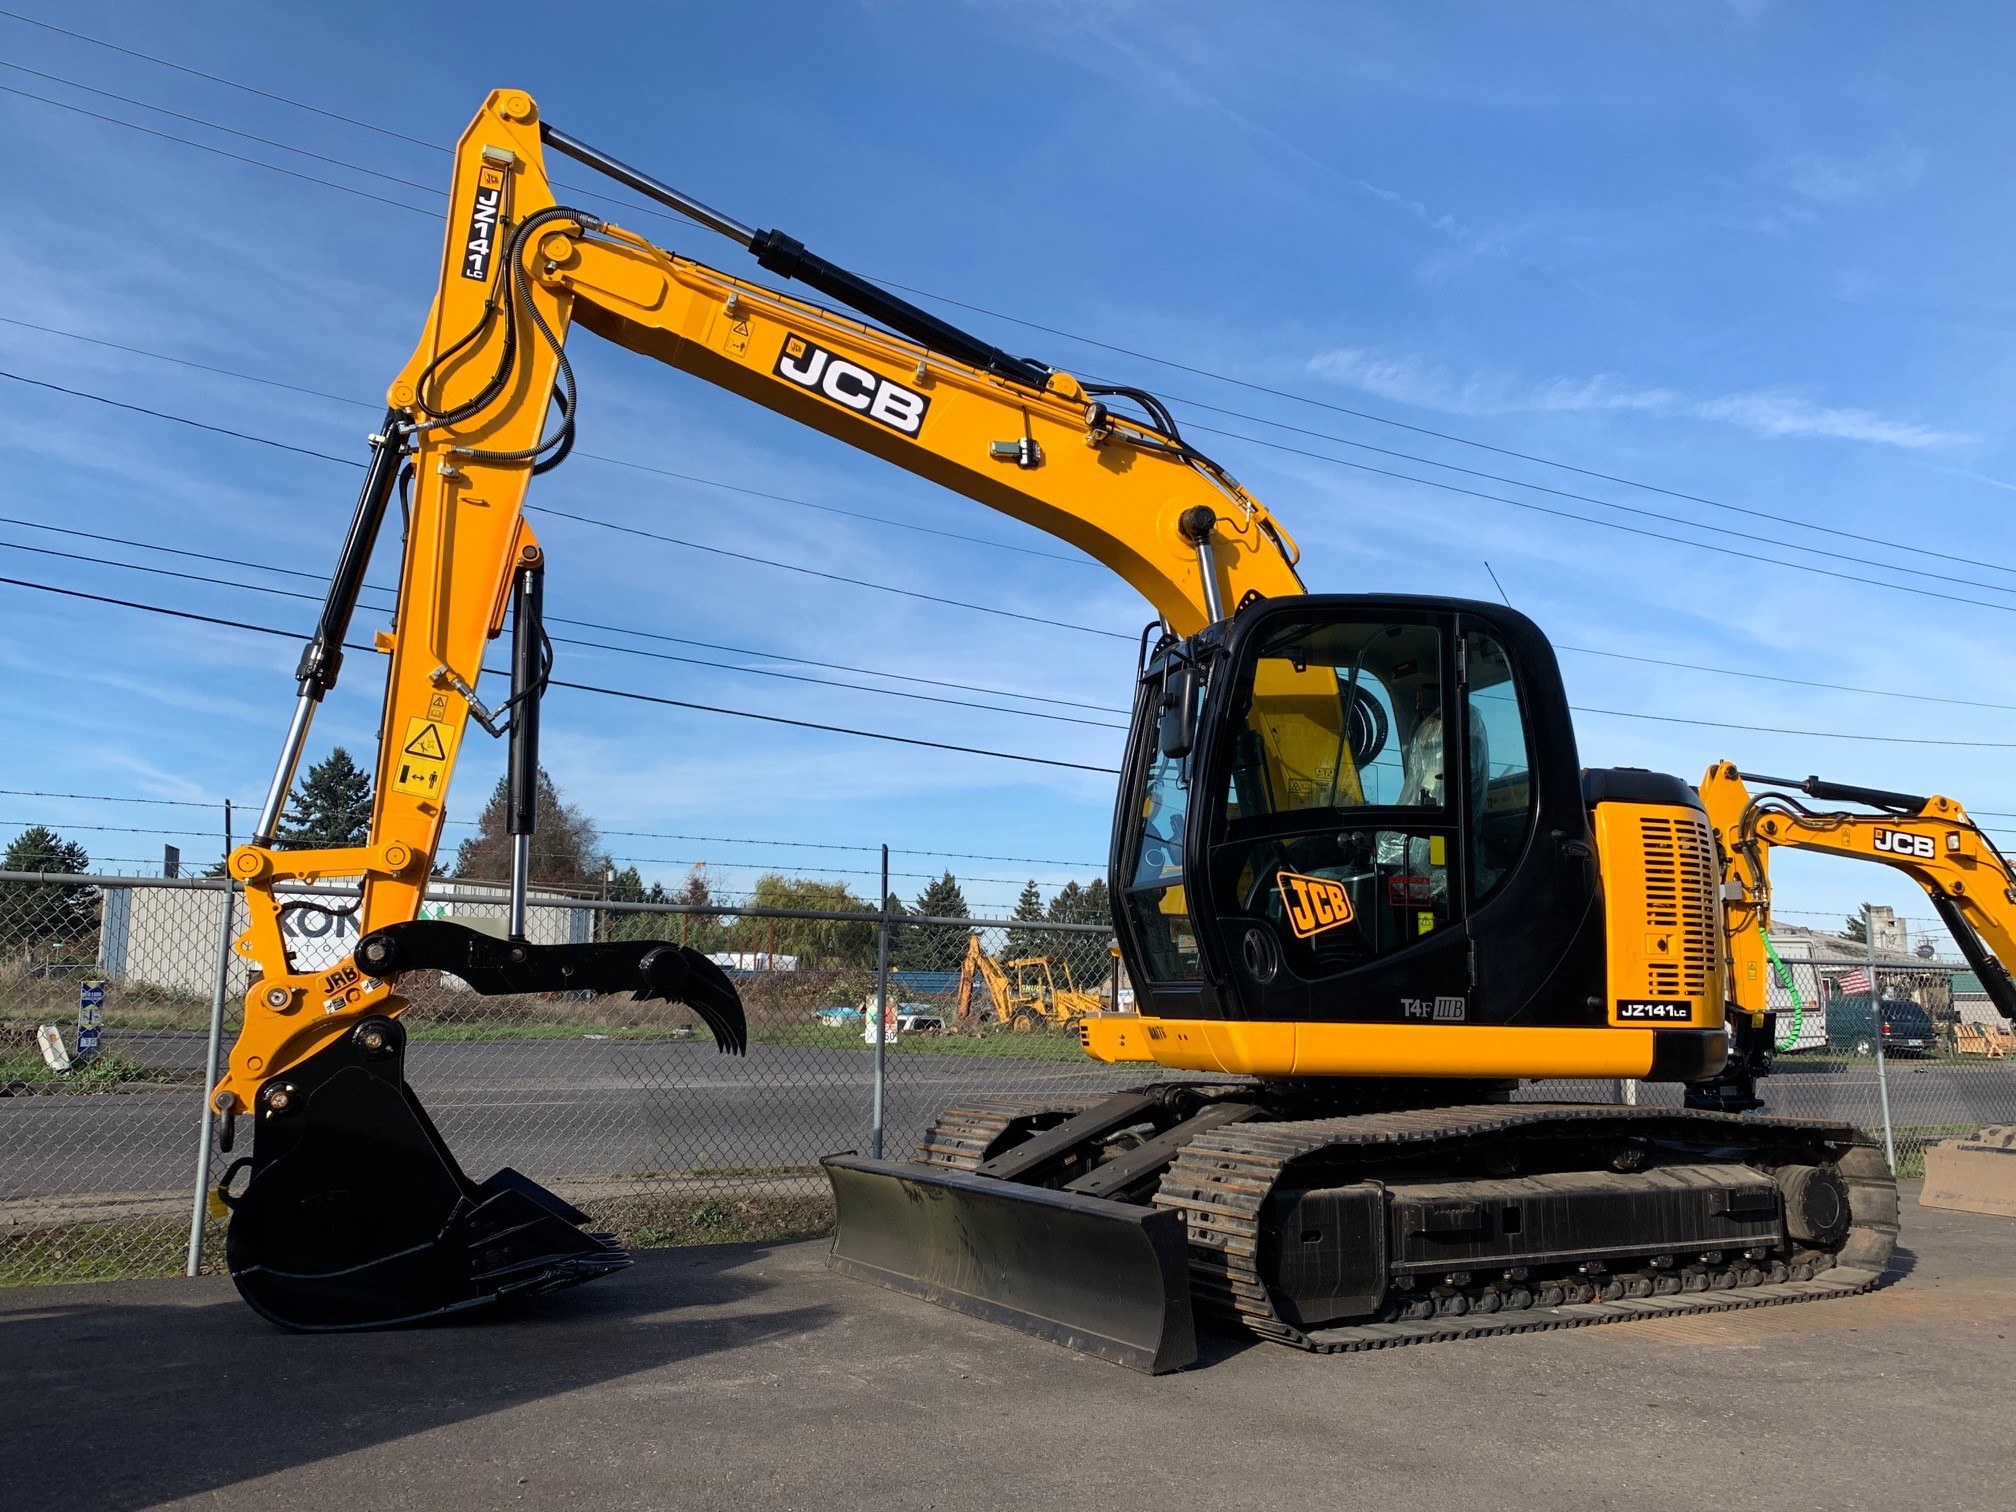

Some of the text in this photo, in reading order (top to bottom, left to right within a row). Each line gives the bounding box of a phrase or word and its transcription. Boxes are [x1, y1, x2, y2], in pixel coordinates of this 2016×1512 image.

[780, 349, 924, 432] JCB
[1875, 831, 1934, 858] JCB
[1290, 879, 1348, 931] JCB
[324, 966, 358, 993] JRB
[1400, 998, 1433, 1018] T4F
